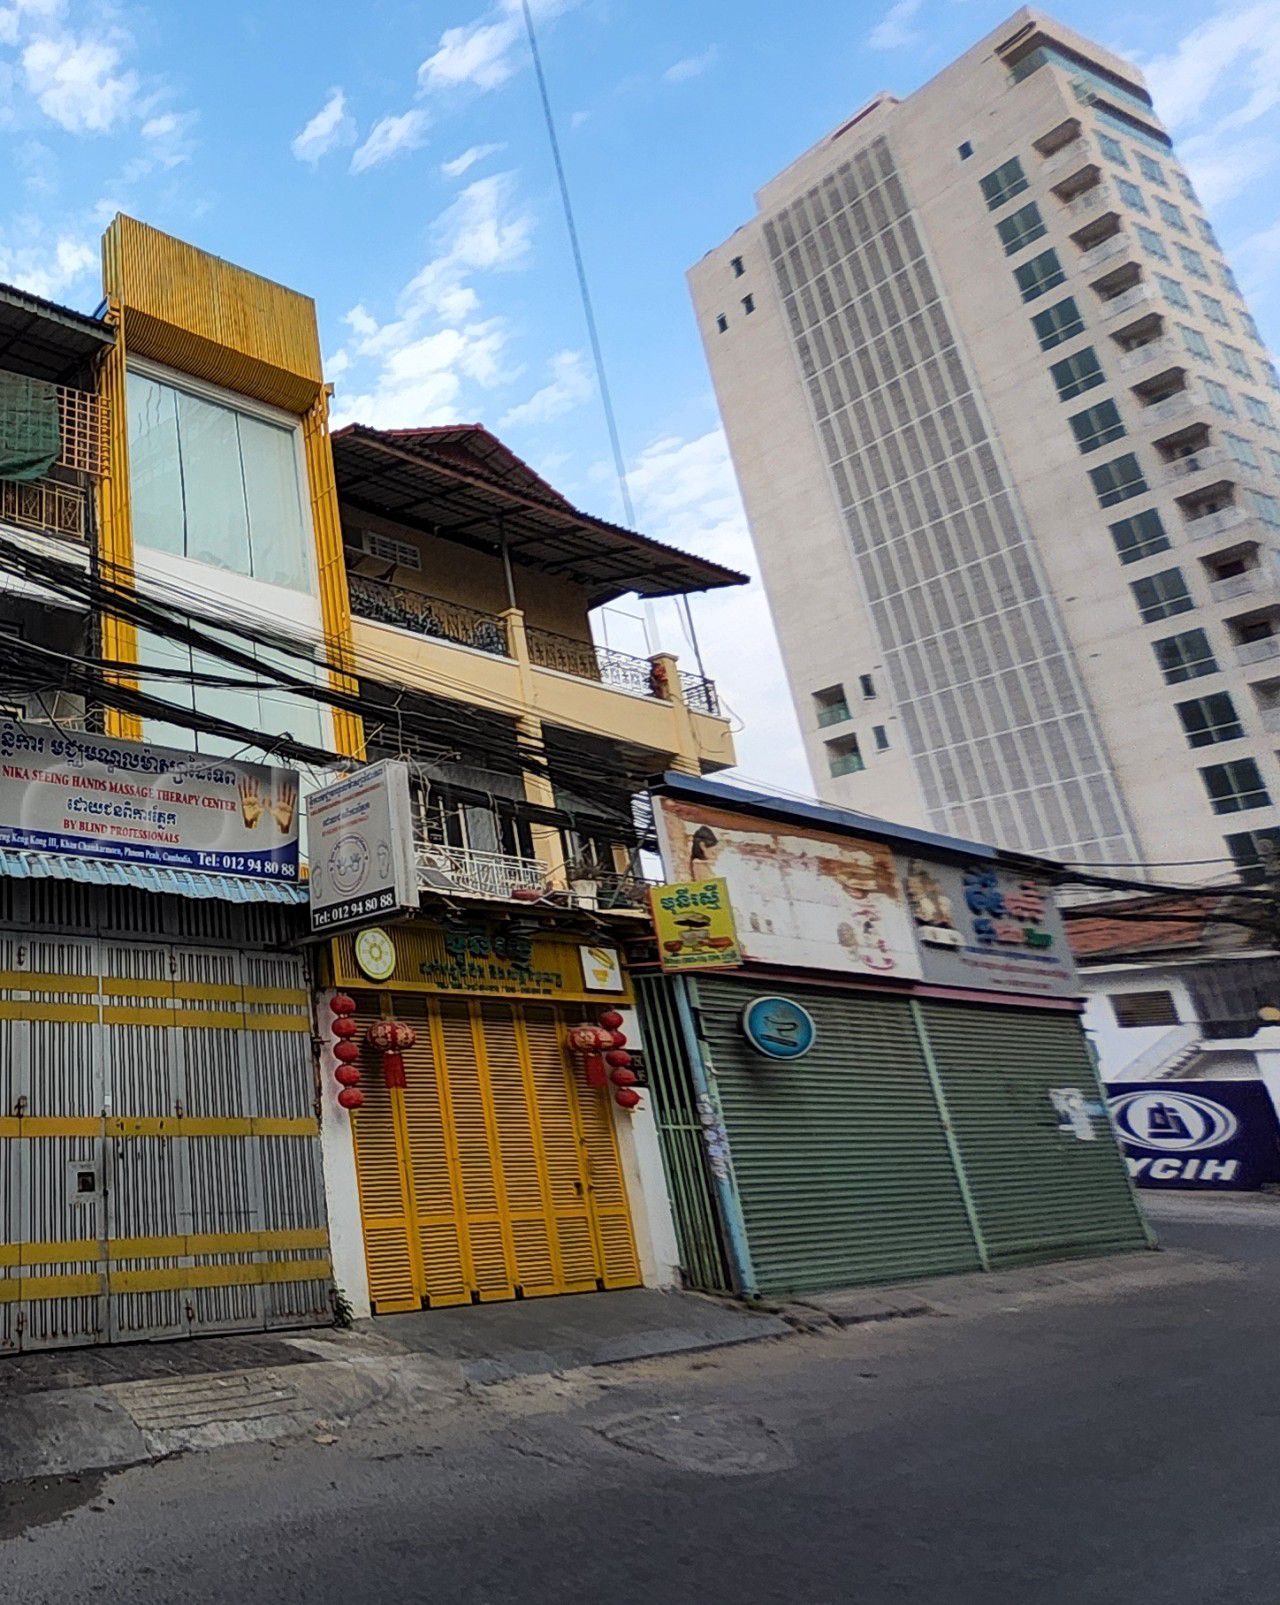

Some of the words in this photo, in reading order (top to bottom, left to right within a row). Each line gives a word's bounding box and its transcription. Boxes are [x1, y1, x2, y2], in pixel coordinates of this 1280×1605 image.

[2, 765, 30, 780] NIKA
[32, 769, 69, 785] SEEING
[72, 775, 107, 791] HANDS
[109, 781, 154, 799] MASSAGE
[156, 789, 200, 806] THERAPY
[202, 797, 237, 812] CENTER
[63, 819, 77, 830] BY
[78, 821, 108, 833] BLIND
[110, 826, 180, 843] PROFESSIONALS
[197, 851, 220, 867] Tel:
[222, 854, 245, 870] 012
[247, 858, 263, 873] 94
[264, 860, 280, 875] 80
[281, 862, 296, 876] 88
[314, 910, 330, 926] Tel:
[332, 905, 349, 921] 012
[350, 902, 363, 916] 94
[365, 897, 378, 912] 80
[379, 893, 393, 907] 88
